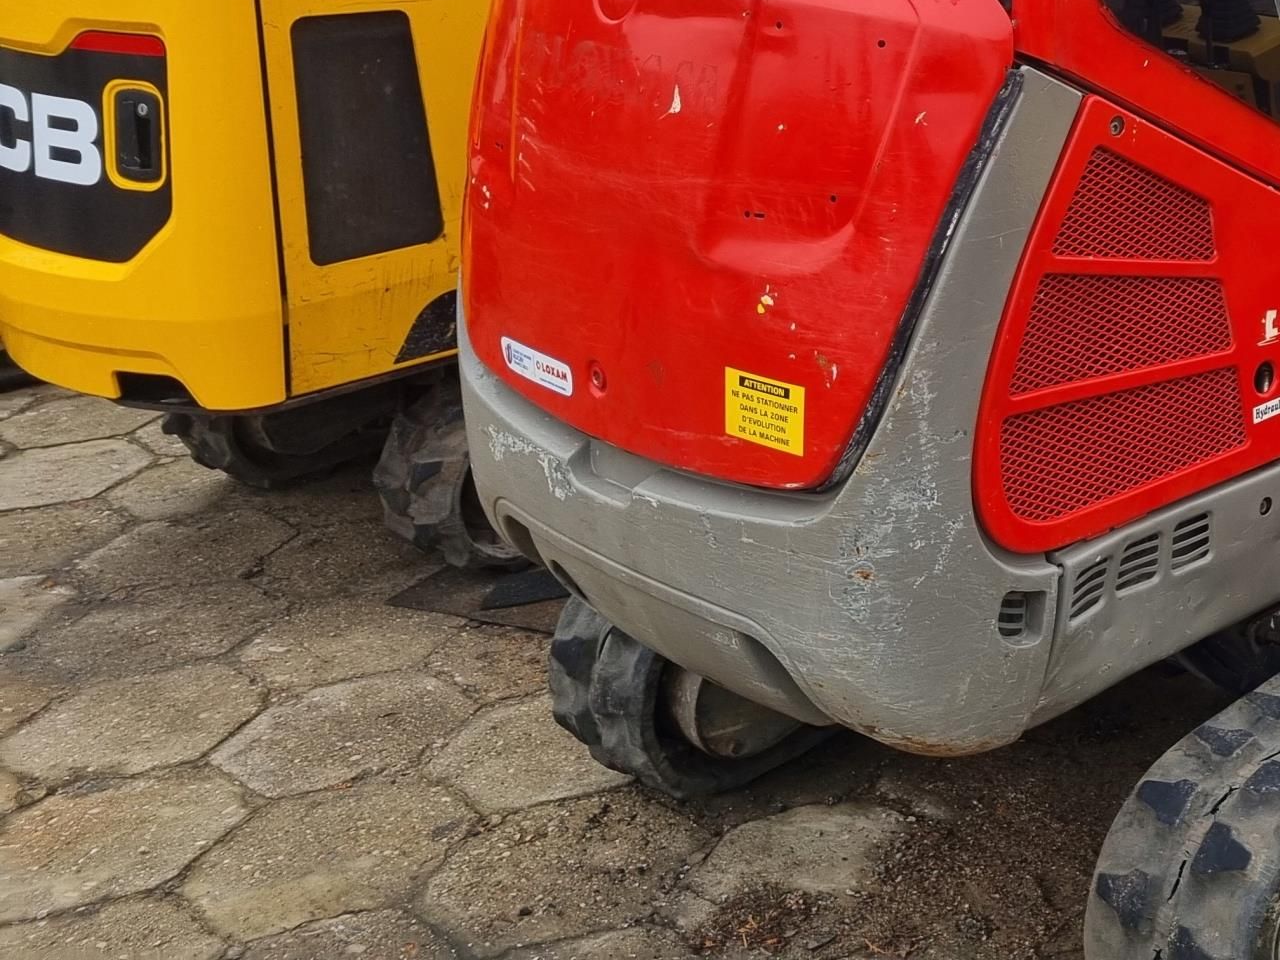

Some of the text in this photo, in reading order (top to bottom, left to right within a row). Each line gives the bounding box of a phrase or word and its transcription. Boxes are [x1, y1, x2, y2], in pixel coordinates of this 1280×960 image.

[541, 362, 568, 383] LOXAM
[743, 379, 785, 397] ATTENTION
[731, 389, 798, 415] NE PAS STATIONNER
[739, 403, 789, 424] DANS LA ZONE
[742, 414, 787, 434] D'EVOLUTION
[738, 425, 791, 447] DE LA MACHINE
